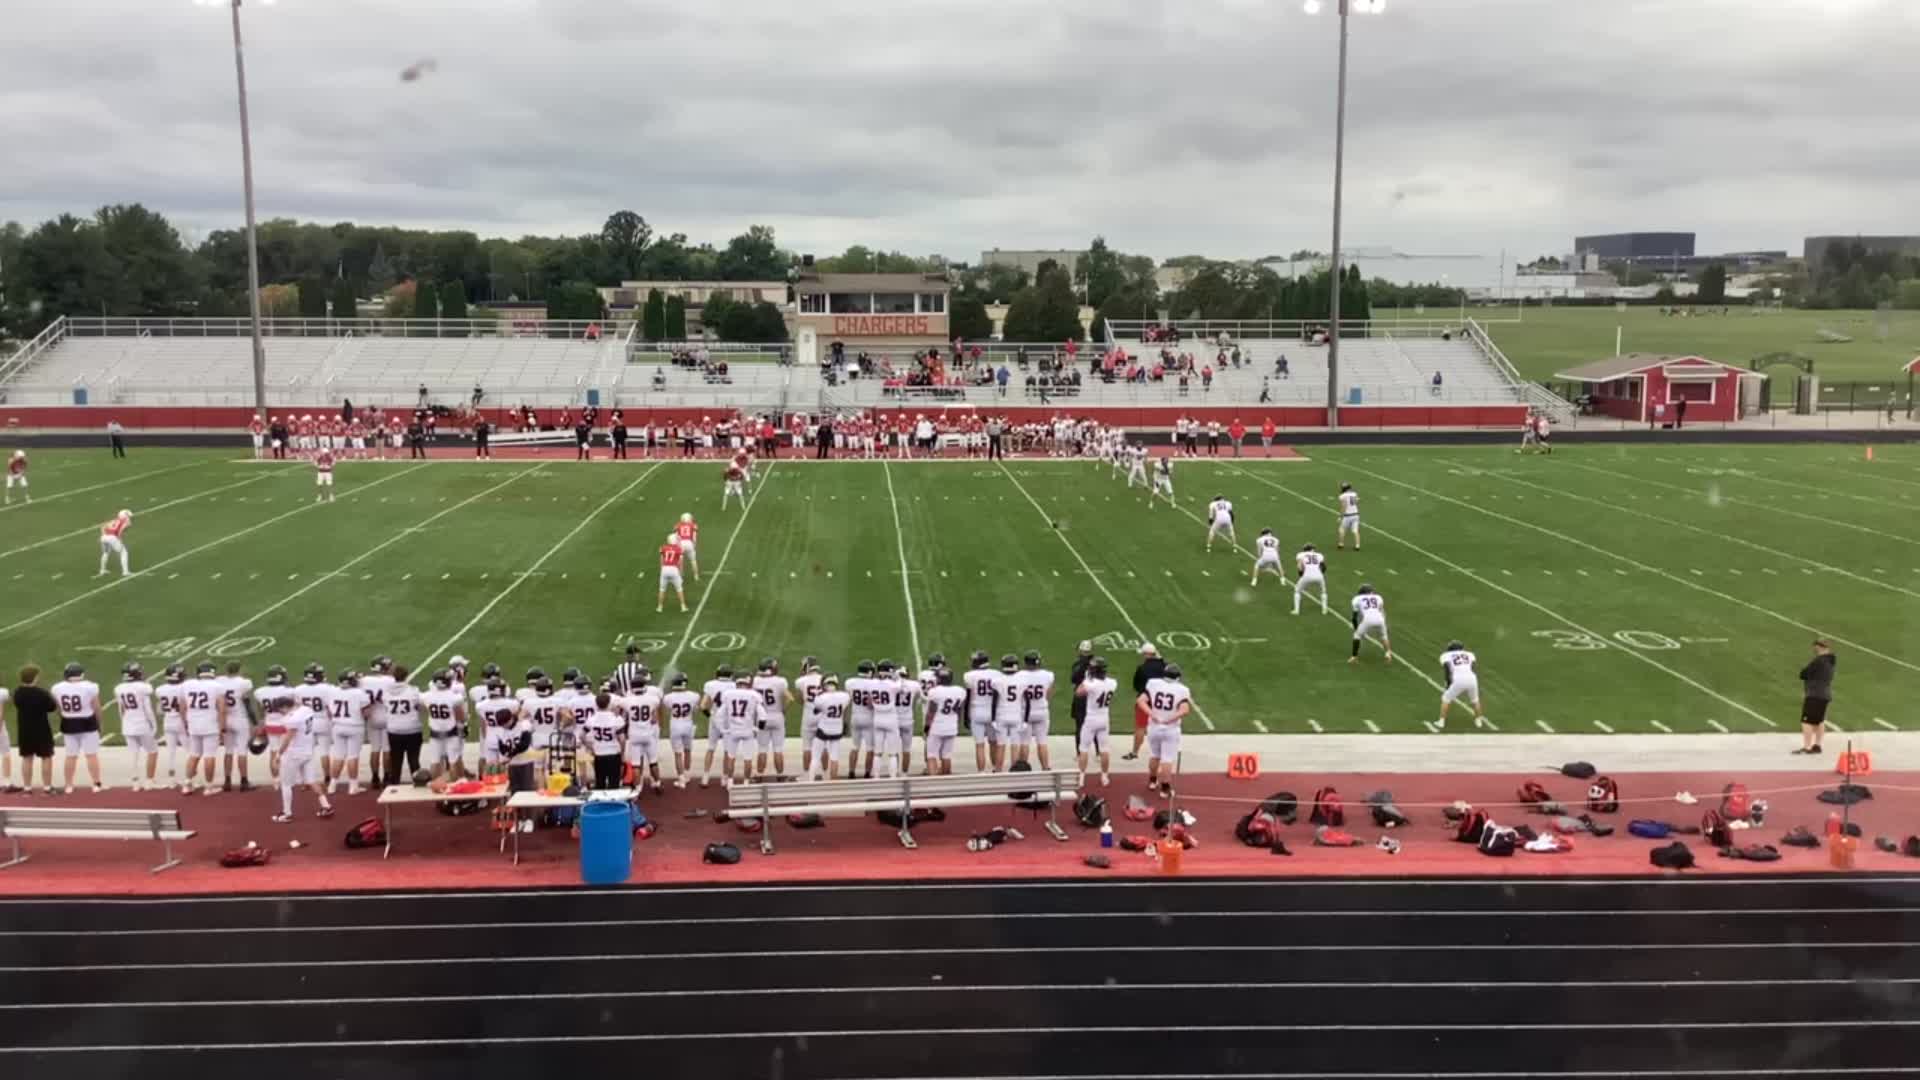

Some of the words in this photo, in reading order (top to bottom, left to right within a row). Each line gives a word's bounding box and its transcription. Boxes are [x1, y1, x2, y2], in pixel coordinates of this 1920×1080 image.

[834, 316, 928, 334] CHARGERS
[664, 549, 676, 563] 17
[1361, 598, 1378, 609] 39
[188, 691, 209, 710] 72
[225, 689, 237, 708] 5
[1008, 685, 1017, 702] 5
[1024, 684, 1044, 701] 66
[1154, 691, 1175, 711] 63
[60, 695, 82, 713] 68
[121, 693, 138, 710] 19
[160, 696, 181, 713] 24
[333, 700, 351, 718] 71
[389, 699, 411, 715] 73
[671, 702, 692, 718] 32
[731, 699, 749, 717] 17
[429, 703, 451, 720] 86
[533, 707, 554, 725] 45
[630, 704, 650, 722] 38
[592, 727, 613, 741] 35
[1232, 755, 1257, 775] 40
